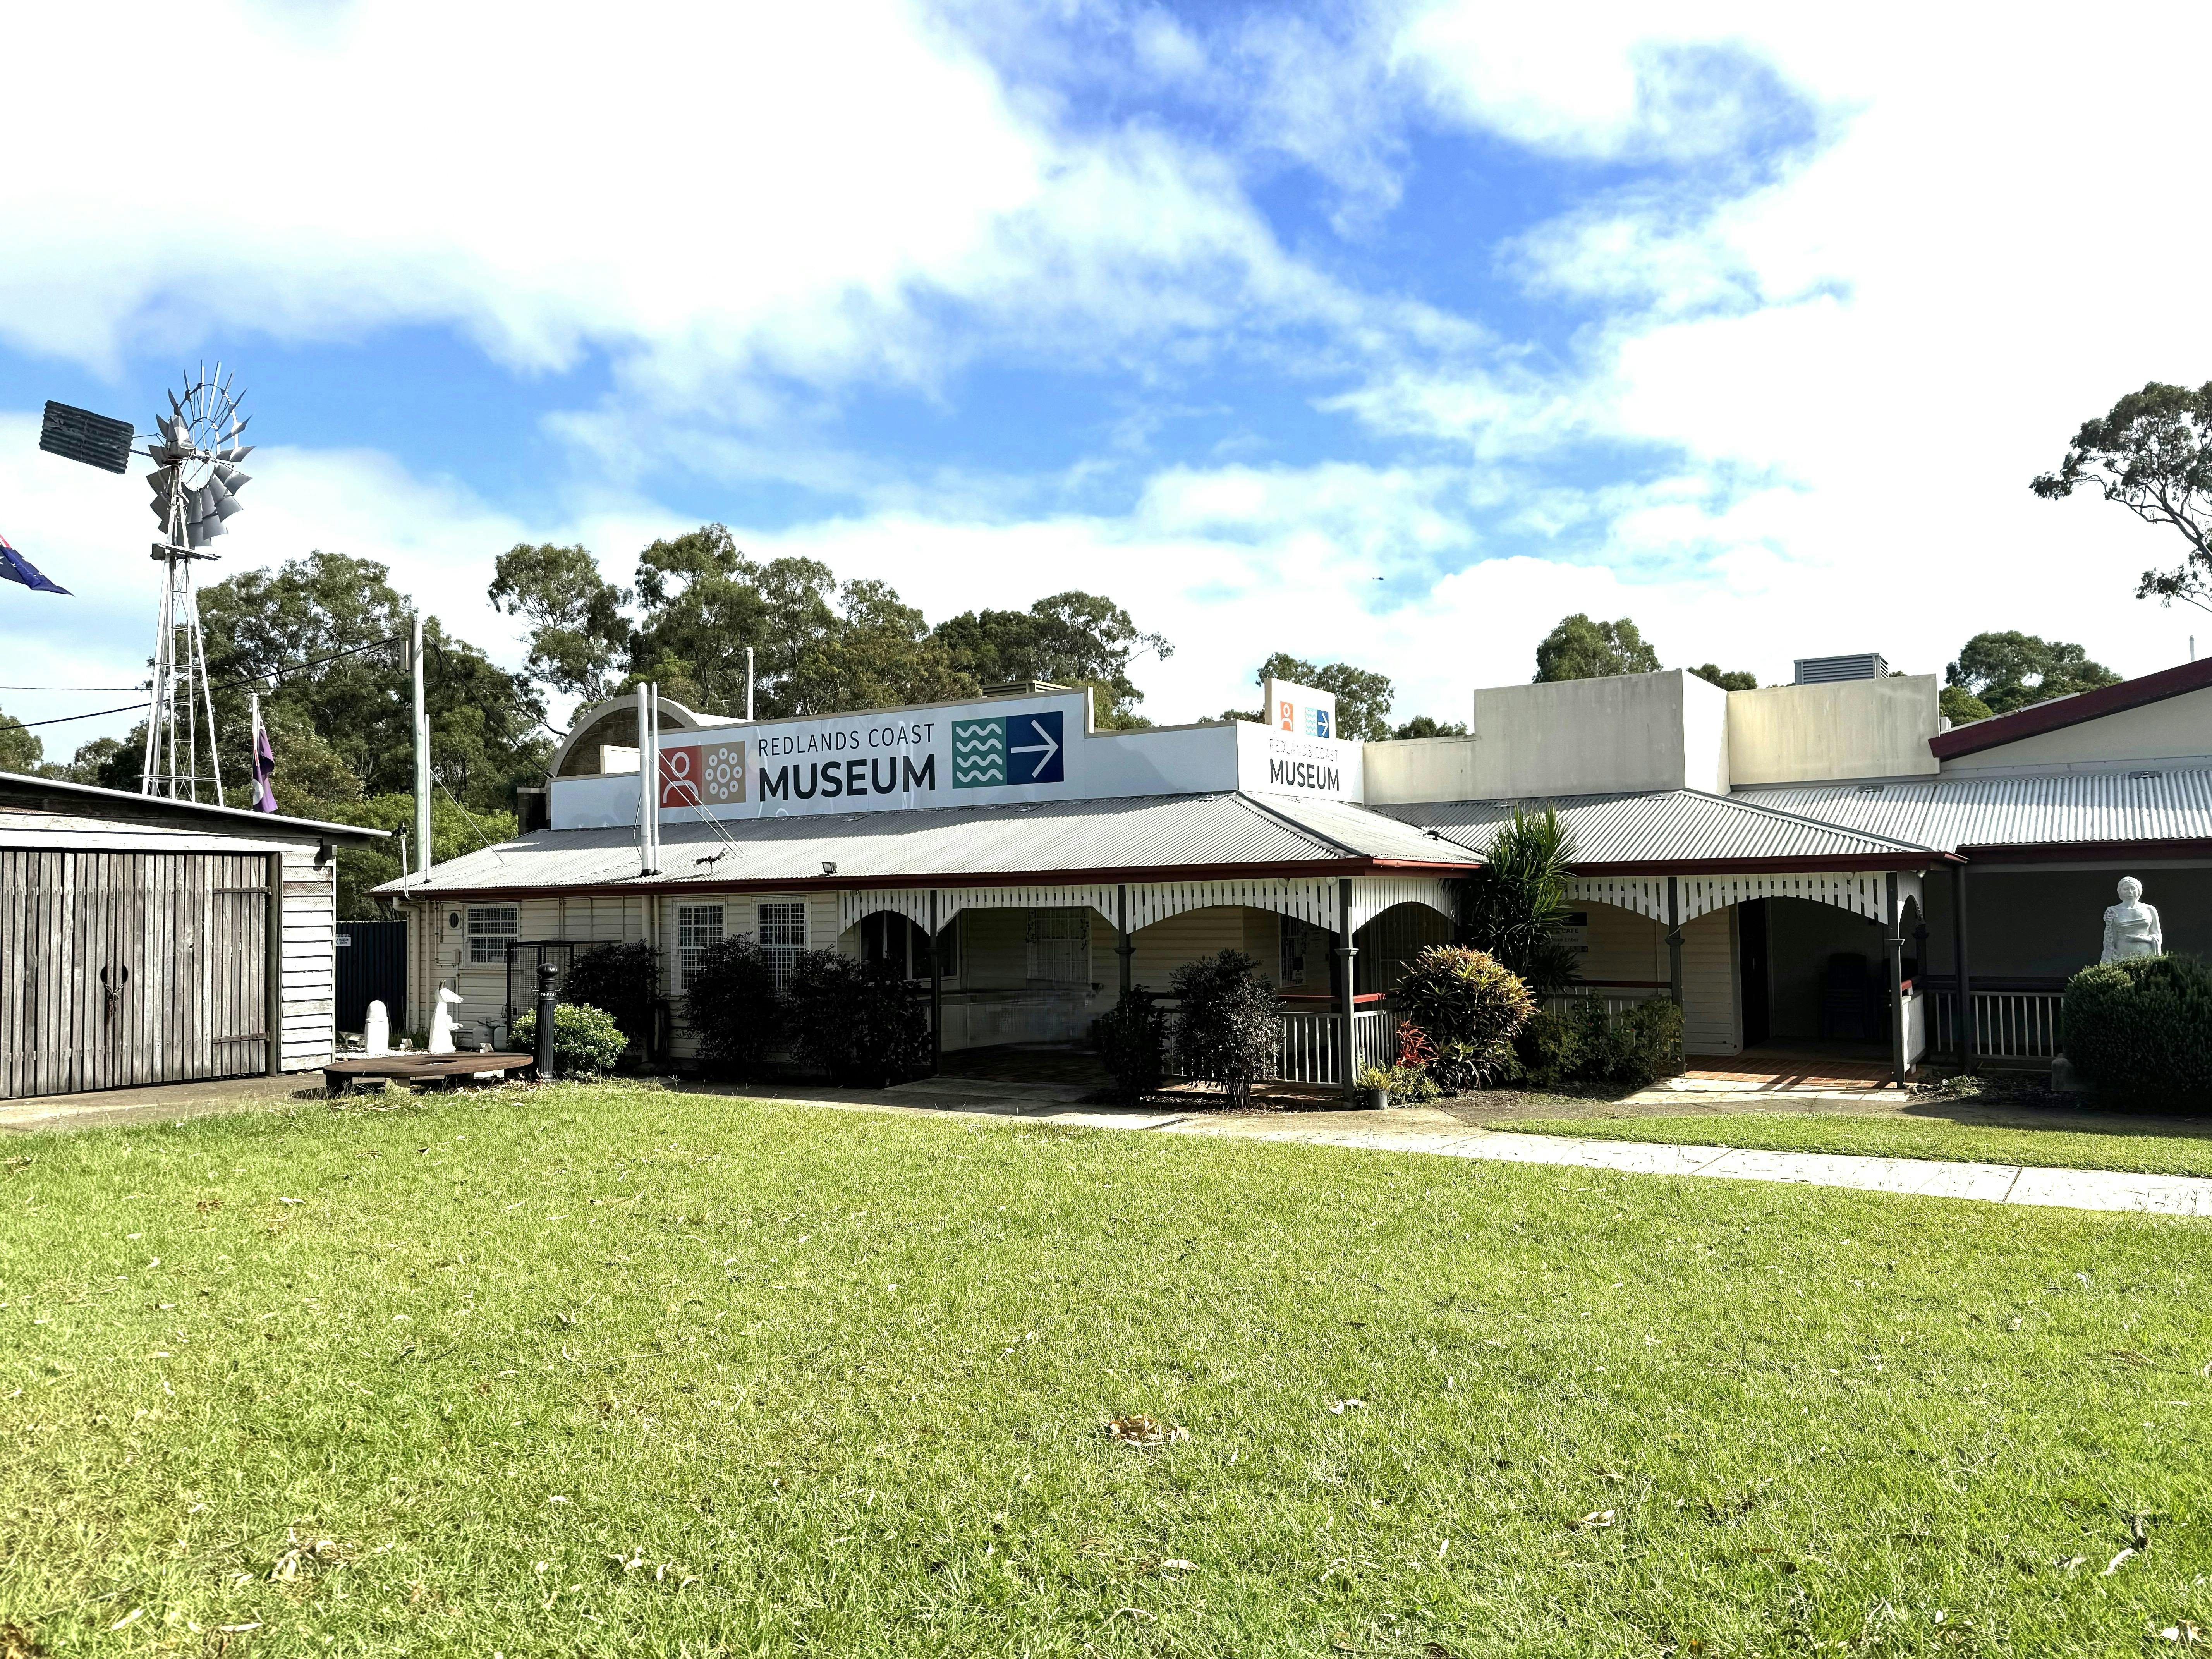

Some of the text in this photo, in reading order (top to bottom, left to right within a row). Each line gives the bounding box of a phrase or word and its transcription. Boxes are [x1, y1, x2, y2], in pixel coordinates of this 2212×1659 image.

[759, 723, 935, 756] REDLANDS COAST
[1269, 738, 1338, 762] REDLANDS COAST
[759, 753, 936, 802] MUSEUM
[1270, 758, 1339, 791] MUSEUM
